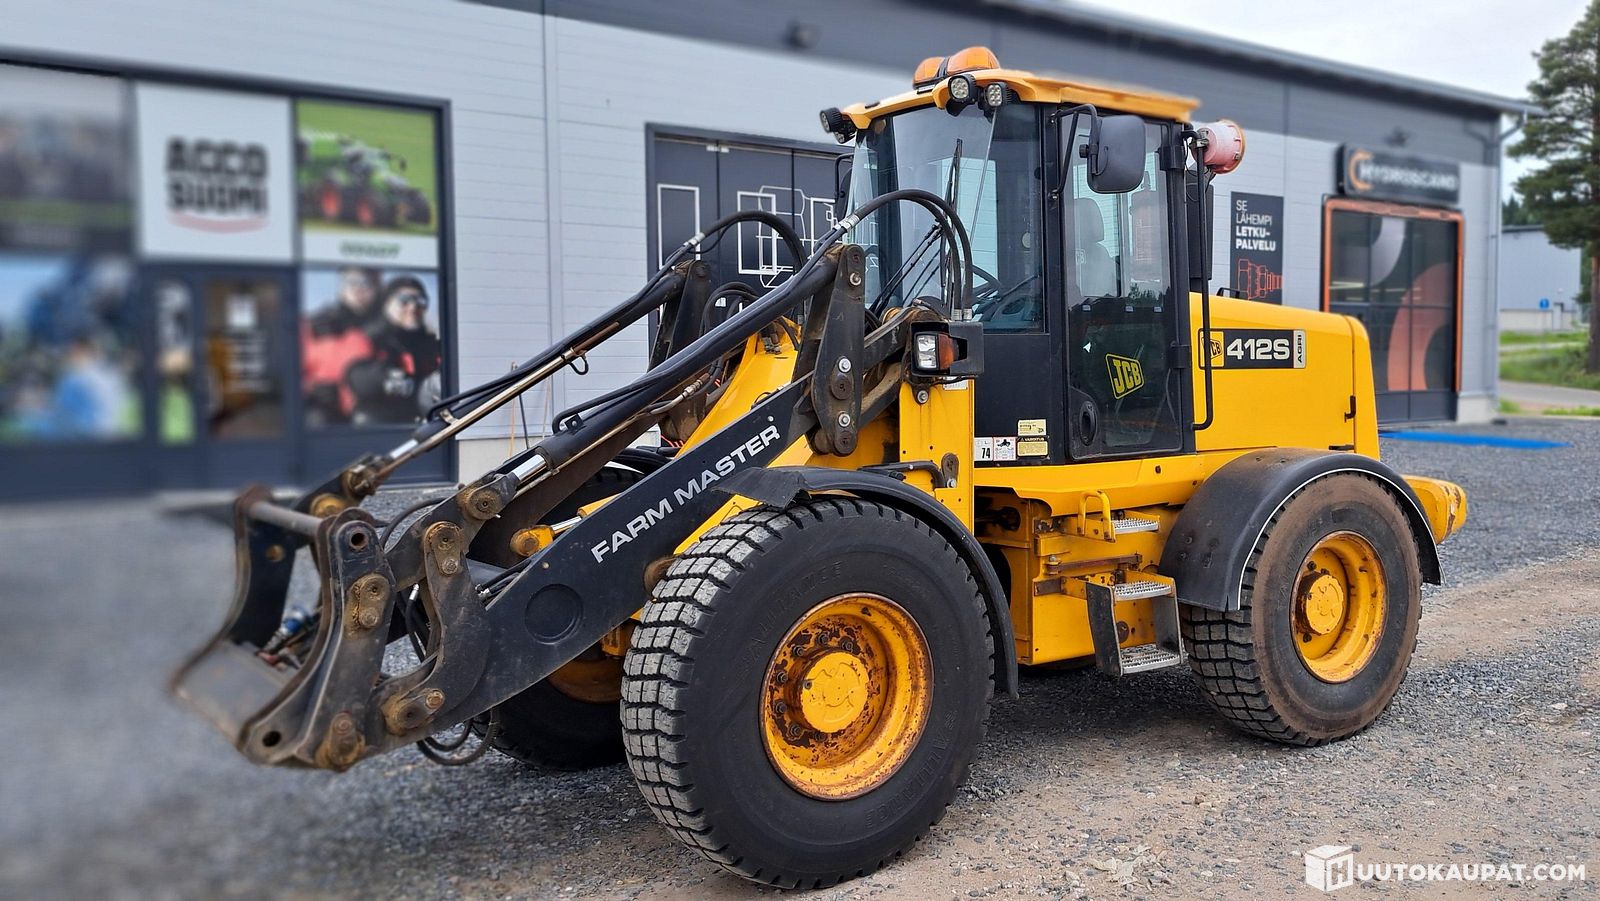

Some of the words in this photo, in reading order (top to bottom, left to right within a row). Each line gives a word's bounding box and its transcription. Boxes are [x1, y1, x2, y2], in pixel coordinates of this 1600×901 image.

[167, 181, 268, 213] SUOMI
[1236, 200, 1248, 211] SE
[1236, 211, 1272, 226] LÄHEMPI
[1236, 226, 1271, 238] LETKU-
[1236, 238, 1276, 251] PALVELU
[1226, 338, 1290, 360] 412S
[1113, 359, 1142, 394] JCB
[981, 447, 991, 459] 74
[591, 498, 673, 563] FARM
[673, 425, 780, 505] MASTER
